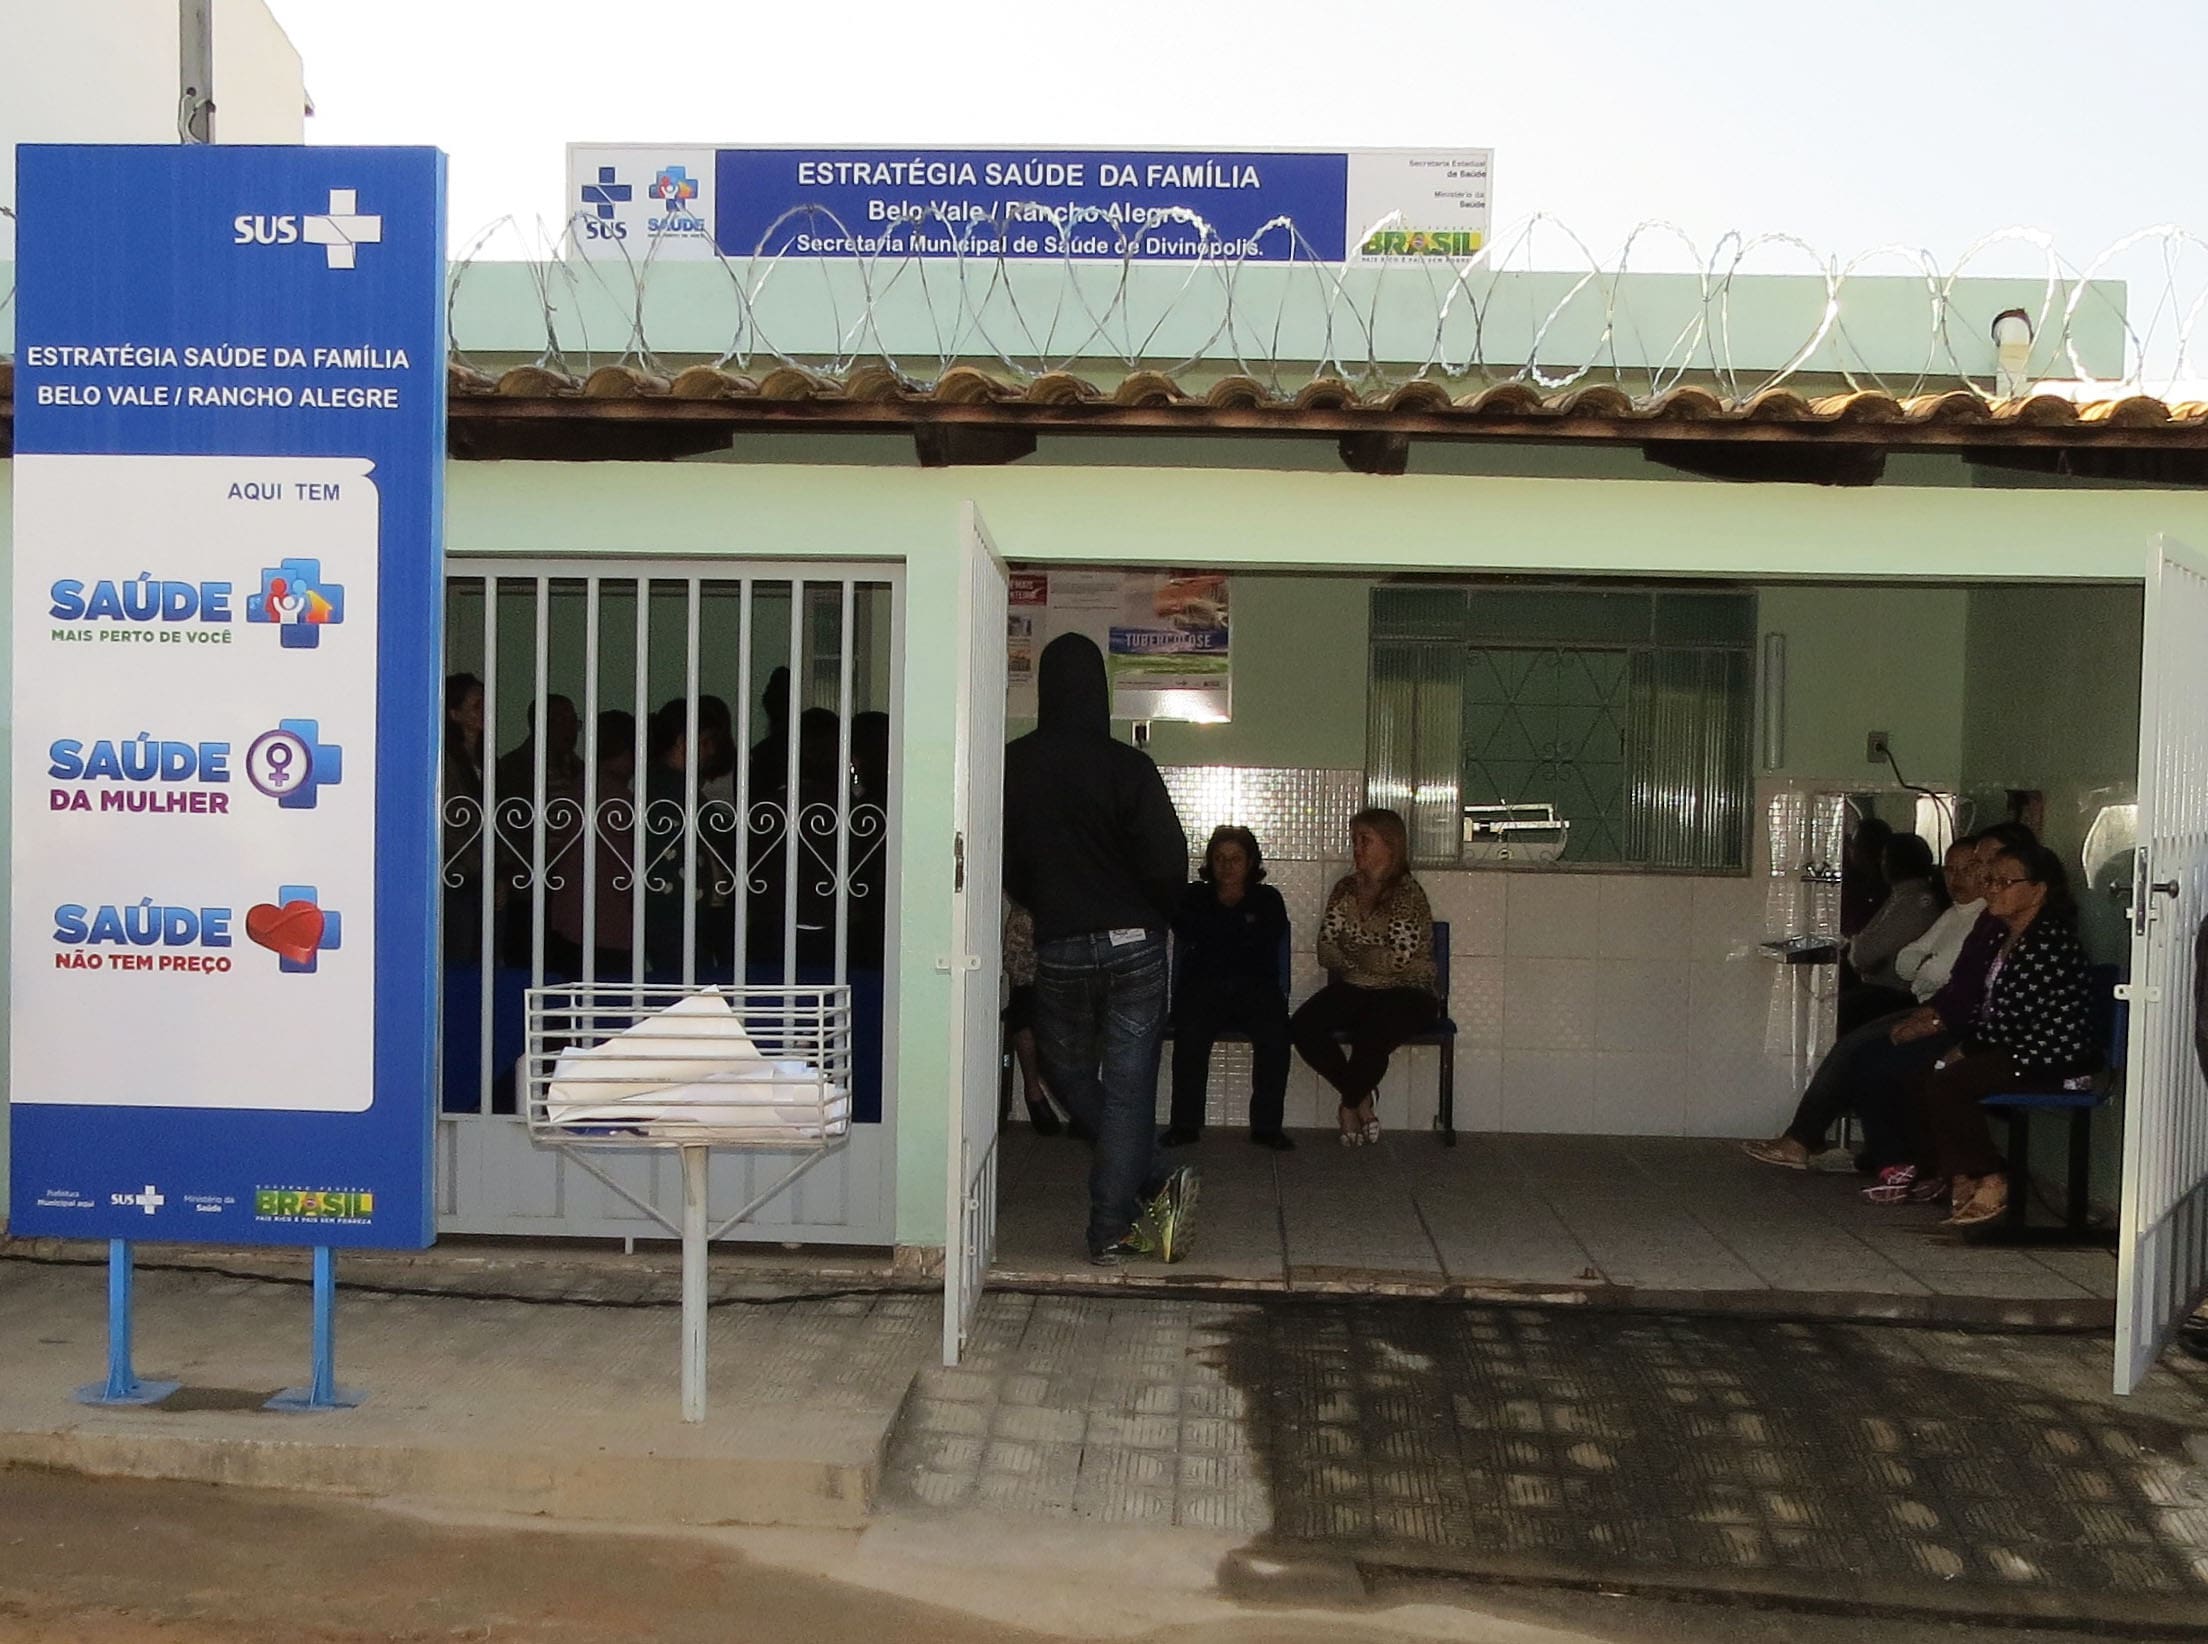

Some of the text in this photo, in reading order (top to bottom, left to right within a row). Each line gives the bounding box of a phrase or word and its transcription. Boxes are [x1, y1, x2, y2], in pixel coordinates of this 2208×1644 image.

[798, 158, 1261, 189] ESTRATÉGIA SAÚDE DA FAMÍLIA
[868, 200, 922, 221] Belo
[930, 200, 985, 221] Vale
[991, 201, 998, 220] /
[1006, 201, 1099, 222] Rancho
[234, 215, 299, 245] SUS
[586, 222, 627, 240] SUS
[797, 235, 903, 253] Secretaria
[910, 235, 1006, 256] Municipal
[1013, 236, 1037, 253] de
[1044, 235, 1108, 254] Saúde
[1114, 237, 1140, 254] de
[1362, 231, 1483, 257] BRASIL
[27, 343, 410, 370] ESTRATÉGIA SAÚDE DA FAMÍLIA
[38, 386, 399, 409] BELO VALE / RANCHO ALEGRE
[228, 483, 340, 501] AQUI TEM
[49, 570, 232, 623] SAÚDE
[51, 629, 232, 644] MAIS PERTO DE VOCÊ
[48, 731, 230, 783] SAÚDE
[50, 789, 229, 814] DA MULHER
[53, 896, 232, 947] SAÚDE
[55, 949, 232, 975] NÃO TEM PREÇO
[111, 1193, 135, 1206] SUS
[256, 1190, 374, 1218] BRASIL
